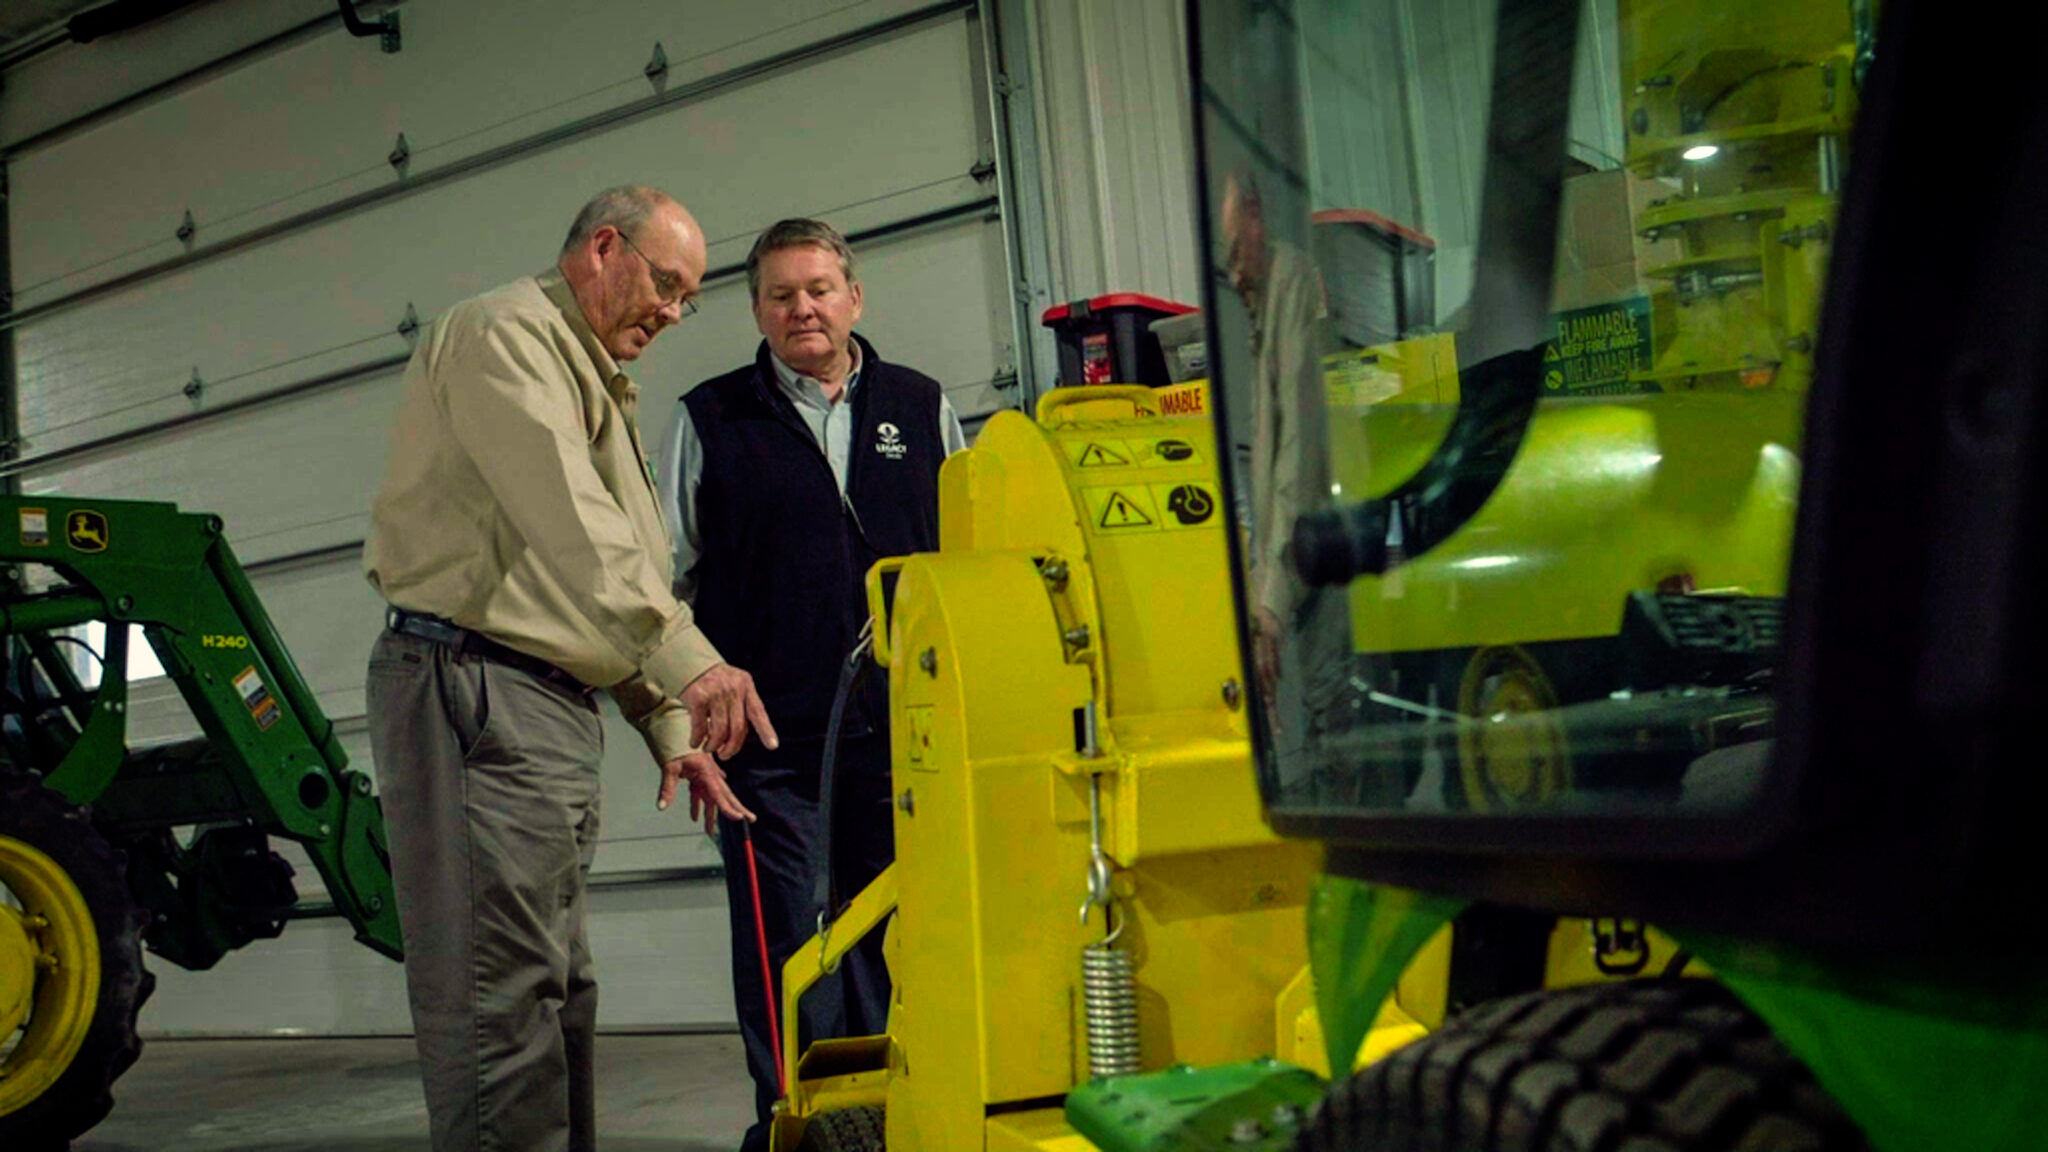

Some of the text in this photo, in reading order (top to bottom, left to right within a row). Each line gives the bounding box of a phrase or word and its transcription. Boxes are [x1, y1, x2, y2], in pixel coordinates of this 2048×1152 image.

[1558, 306, 1638, 346] FLAMMABLE
[1561, 342, 1585, 358] KEEP
[1586, 338, 1608, 354] FIRE
[202, 634, 249, 649] H240
